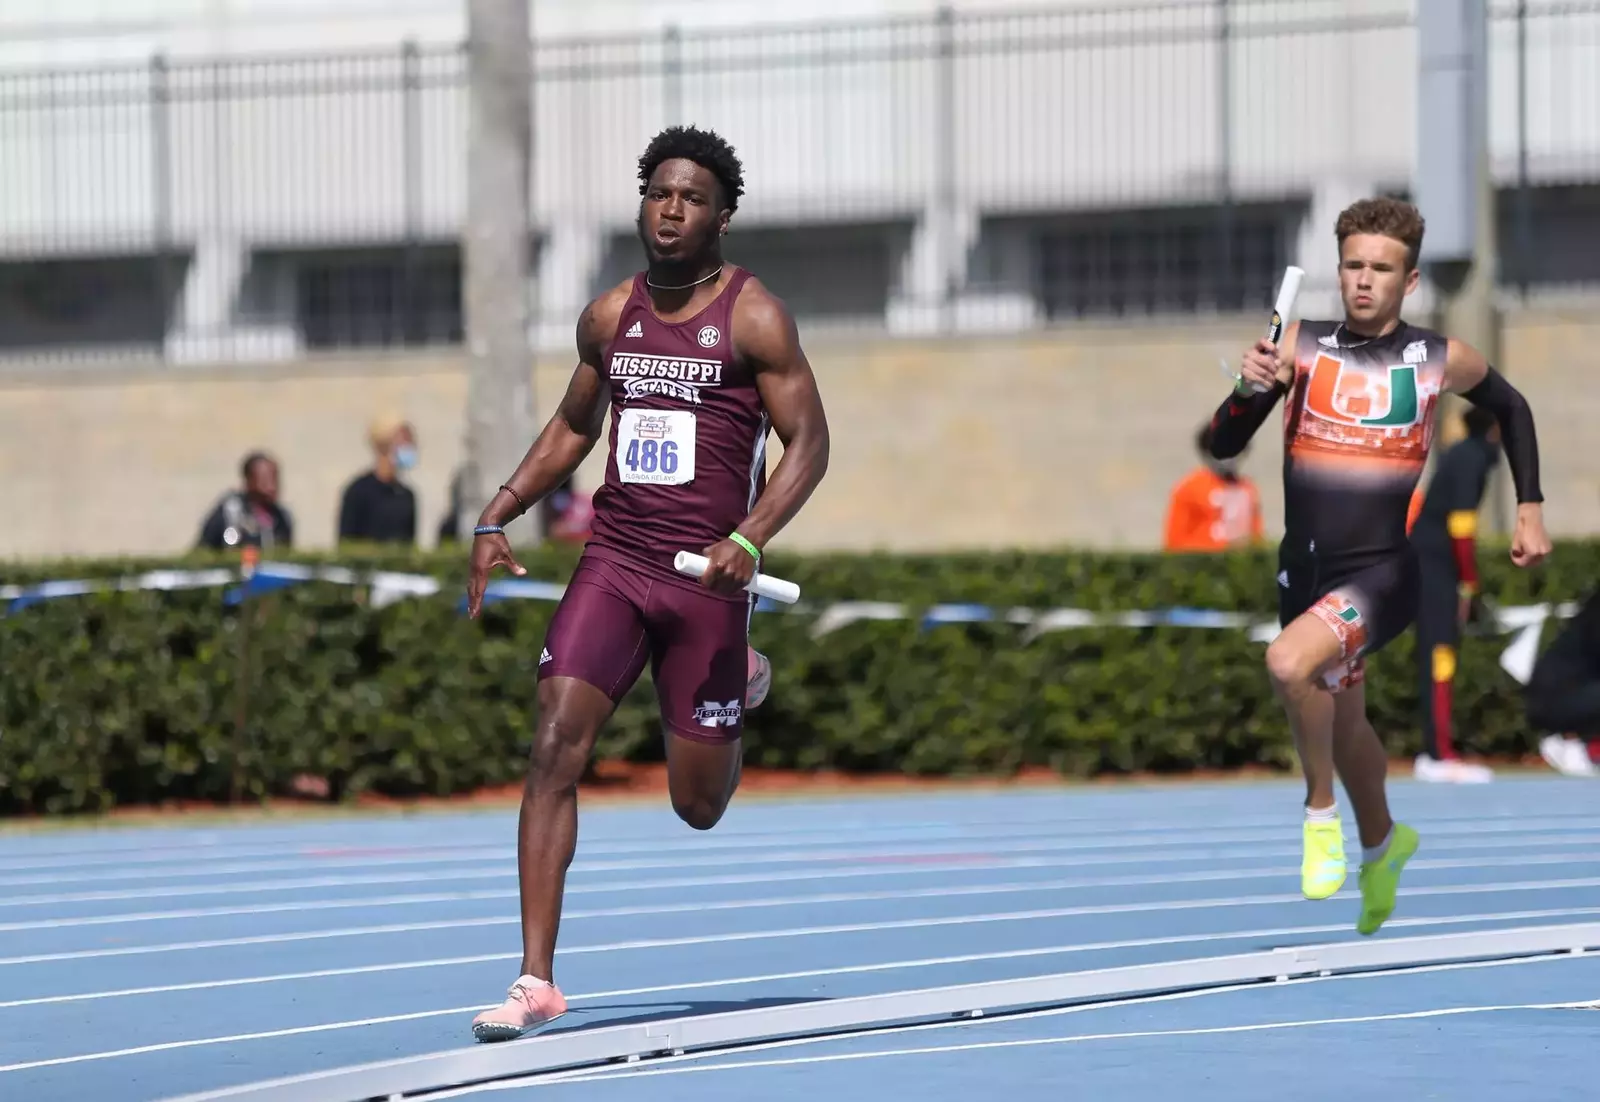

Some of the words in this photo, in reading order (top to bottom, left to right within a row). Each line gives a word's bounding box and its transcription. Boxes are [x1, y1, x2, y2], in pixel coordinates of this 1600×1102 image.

[625, 330, 643, 338] adidas
[700, 328, 718, 346] SEC
[610, 357, 722, 381] MISSISSIPPI
[633, 380, 688, 398] STATE
[1306, 352, 1418, 428] U
[625, 439, 678, 474] 486
[704, 709, 736, 718] STATE
